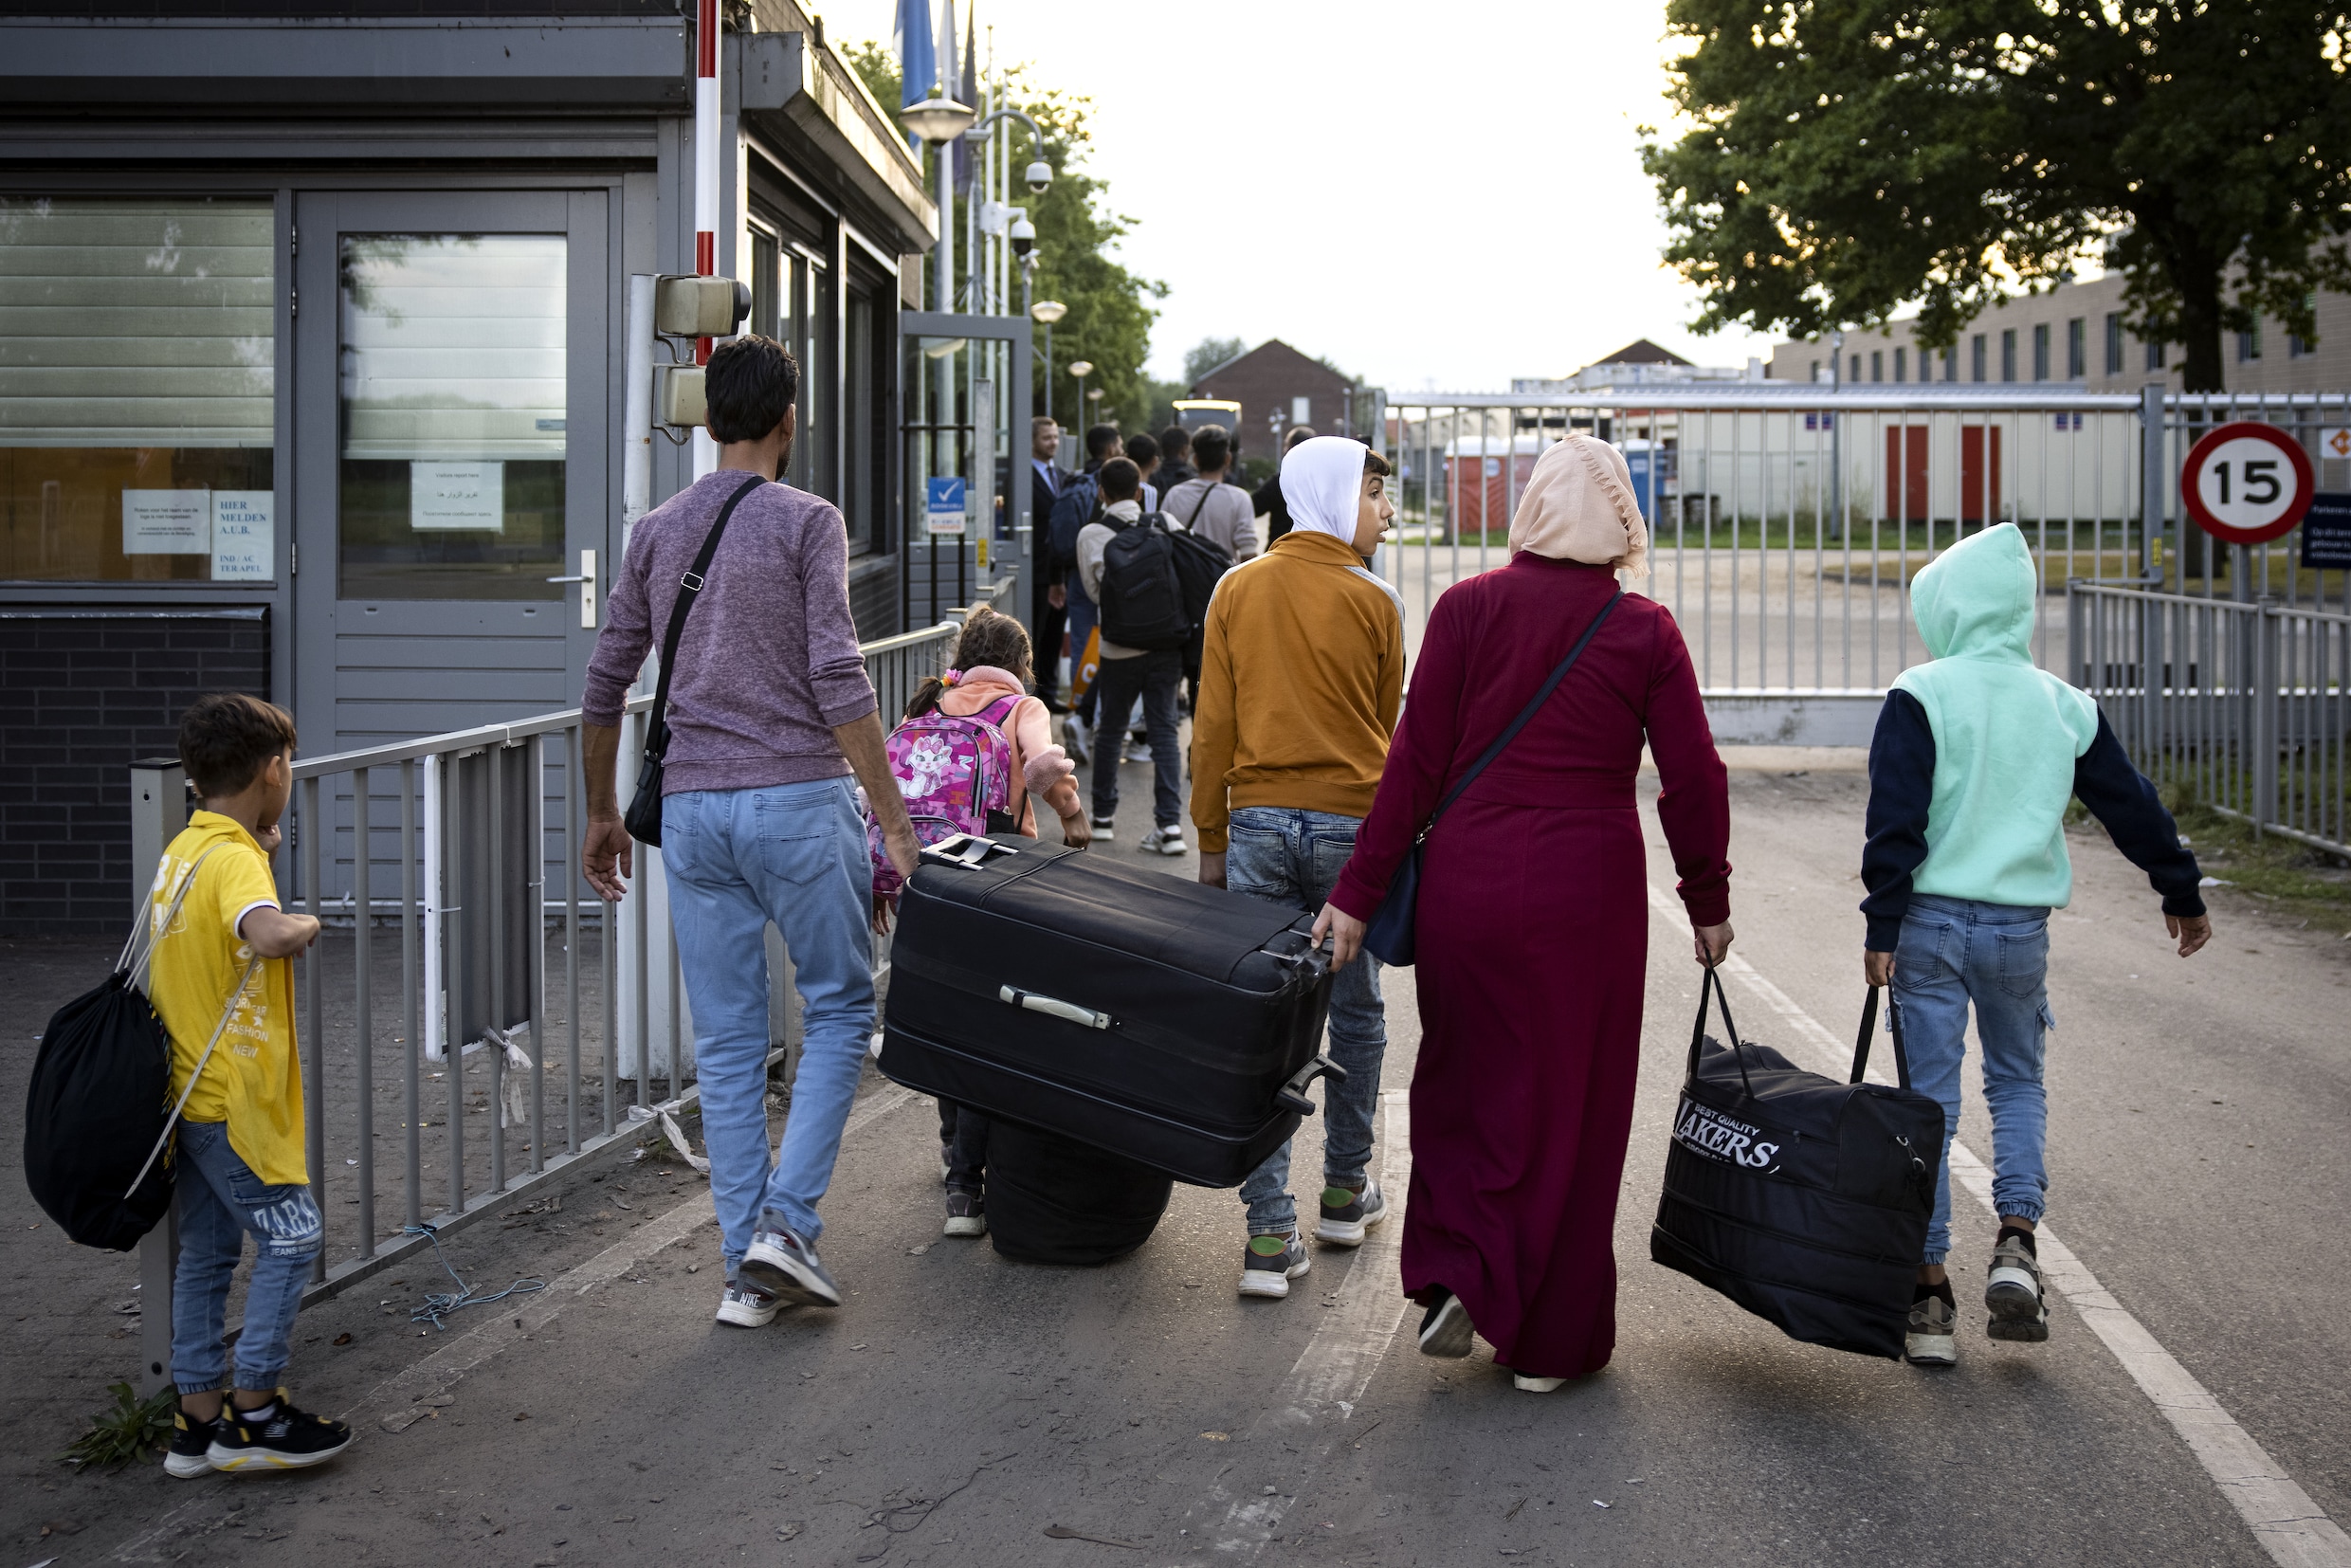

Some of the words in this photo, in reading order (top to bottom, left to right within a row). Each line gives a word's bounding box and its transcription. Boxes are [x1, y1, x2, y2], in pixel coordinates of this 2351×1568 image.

[2214, 461, 2282, 504] 15
[220, 501, 247, 510] HIER
[220, 513, 266, 522] MELDEN
[220, 525, 250, 535] A.U.B.
[220, 564, 238, 573] TER
[240, 564, 263, 573] APEL
[226, 1023, 269, 1042] FASHION
[233, 1044, 258, 1059] NEW
[1695, 1103, 1719, 1120] BEST
[1718, 1114, 1761, 1137] QUALITY
[1674, 1097, 1780, 1168] LAKERS
[253, 1193, 320, 1240] ZARA
[269, 1246, 298, 1256] JEANS
[298, 1242, 319, 1252] WOR
[739, 1291, 762, 1308] NIKE
